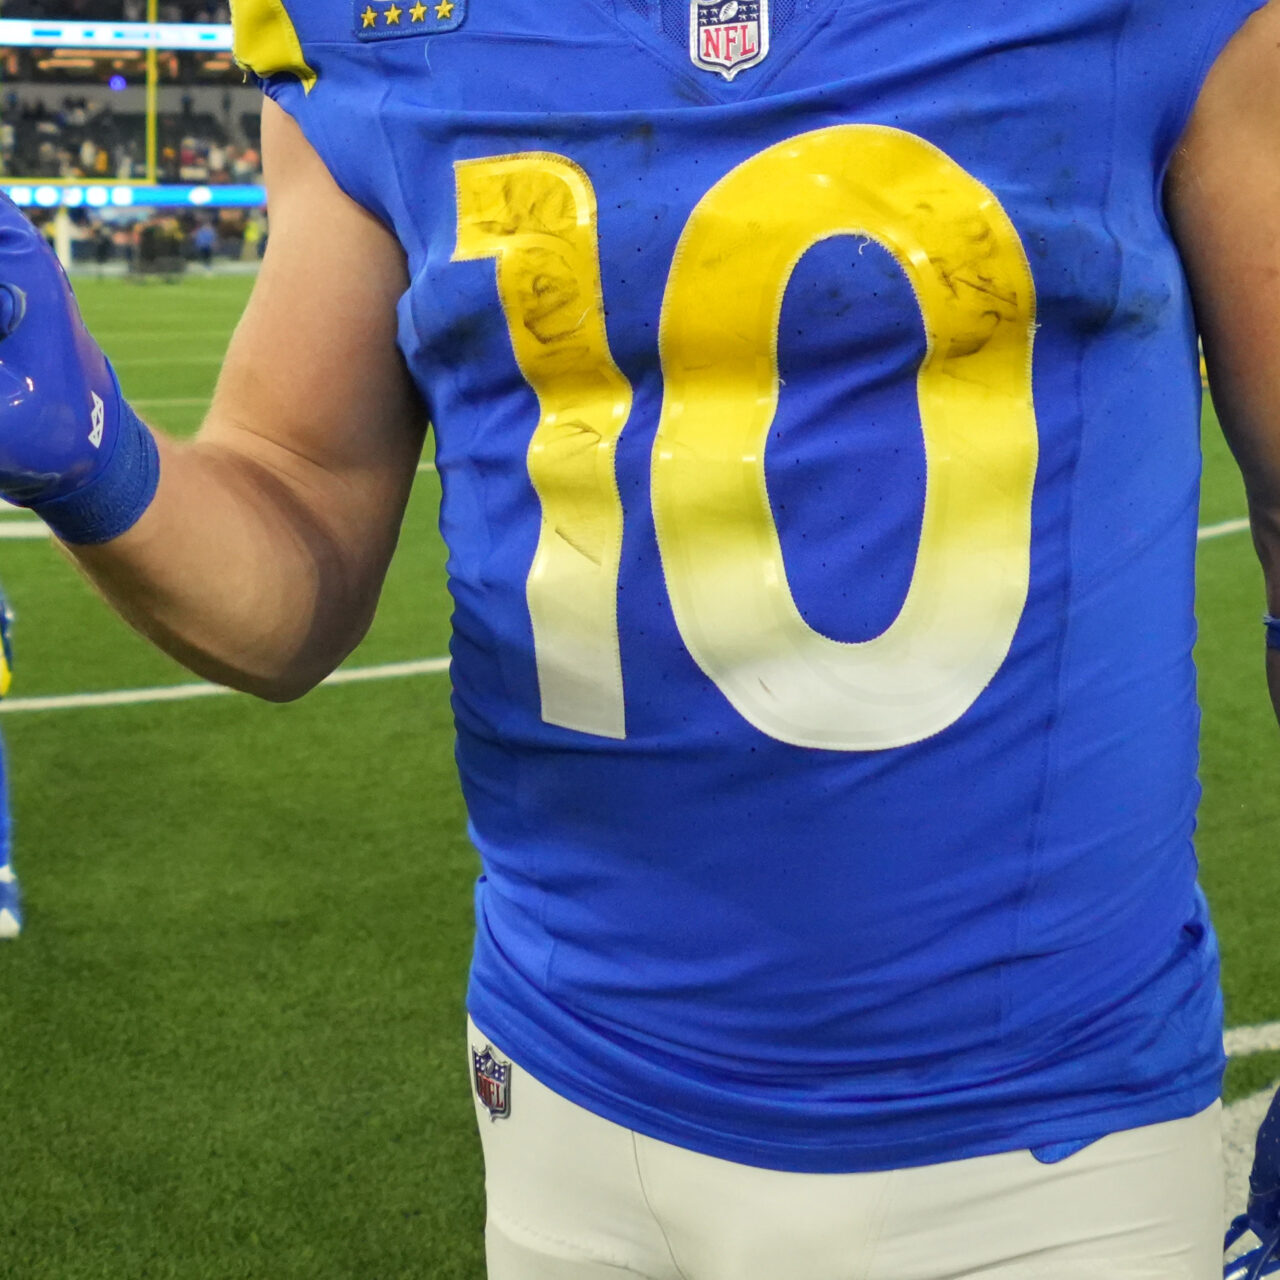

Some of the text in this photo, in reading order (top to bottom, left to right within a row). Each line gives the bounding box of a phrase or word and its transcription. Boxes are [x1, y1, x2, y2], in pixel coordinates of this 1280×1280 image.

[702, 23, 756, 62] NFL
[451, 123, 1039, 753] 10
[476, 1071, 505, 1109] NFL
